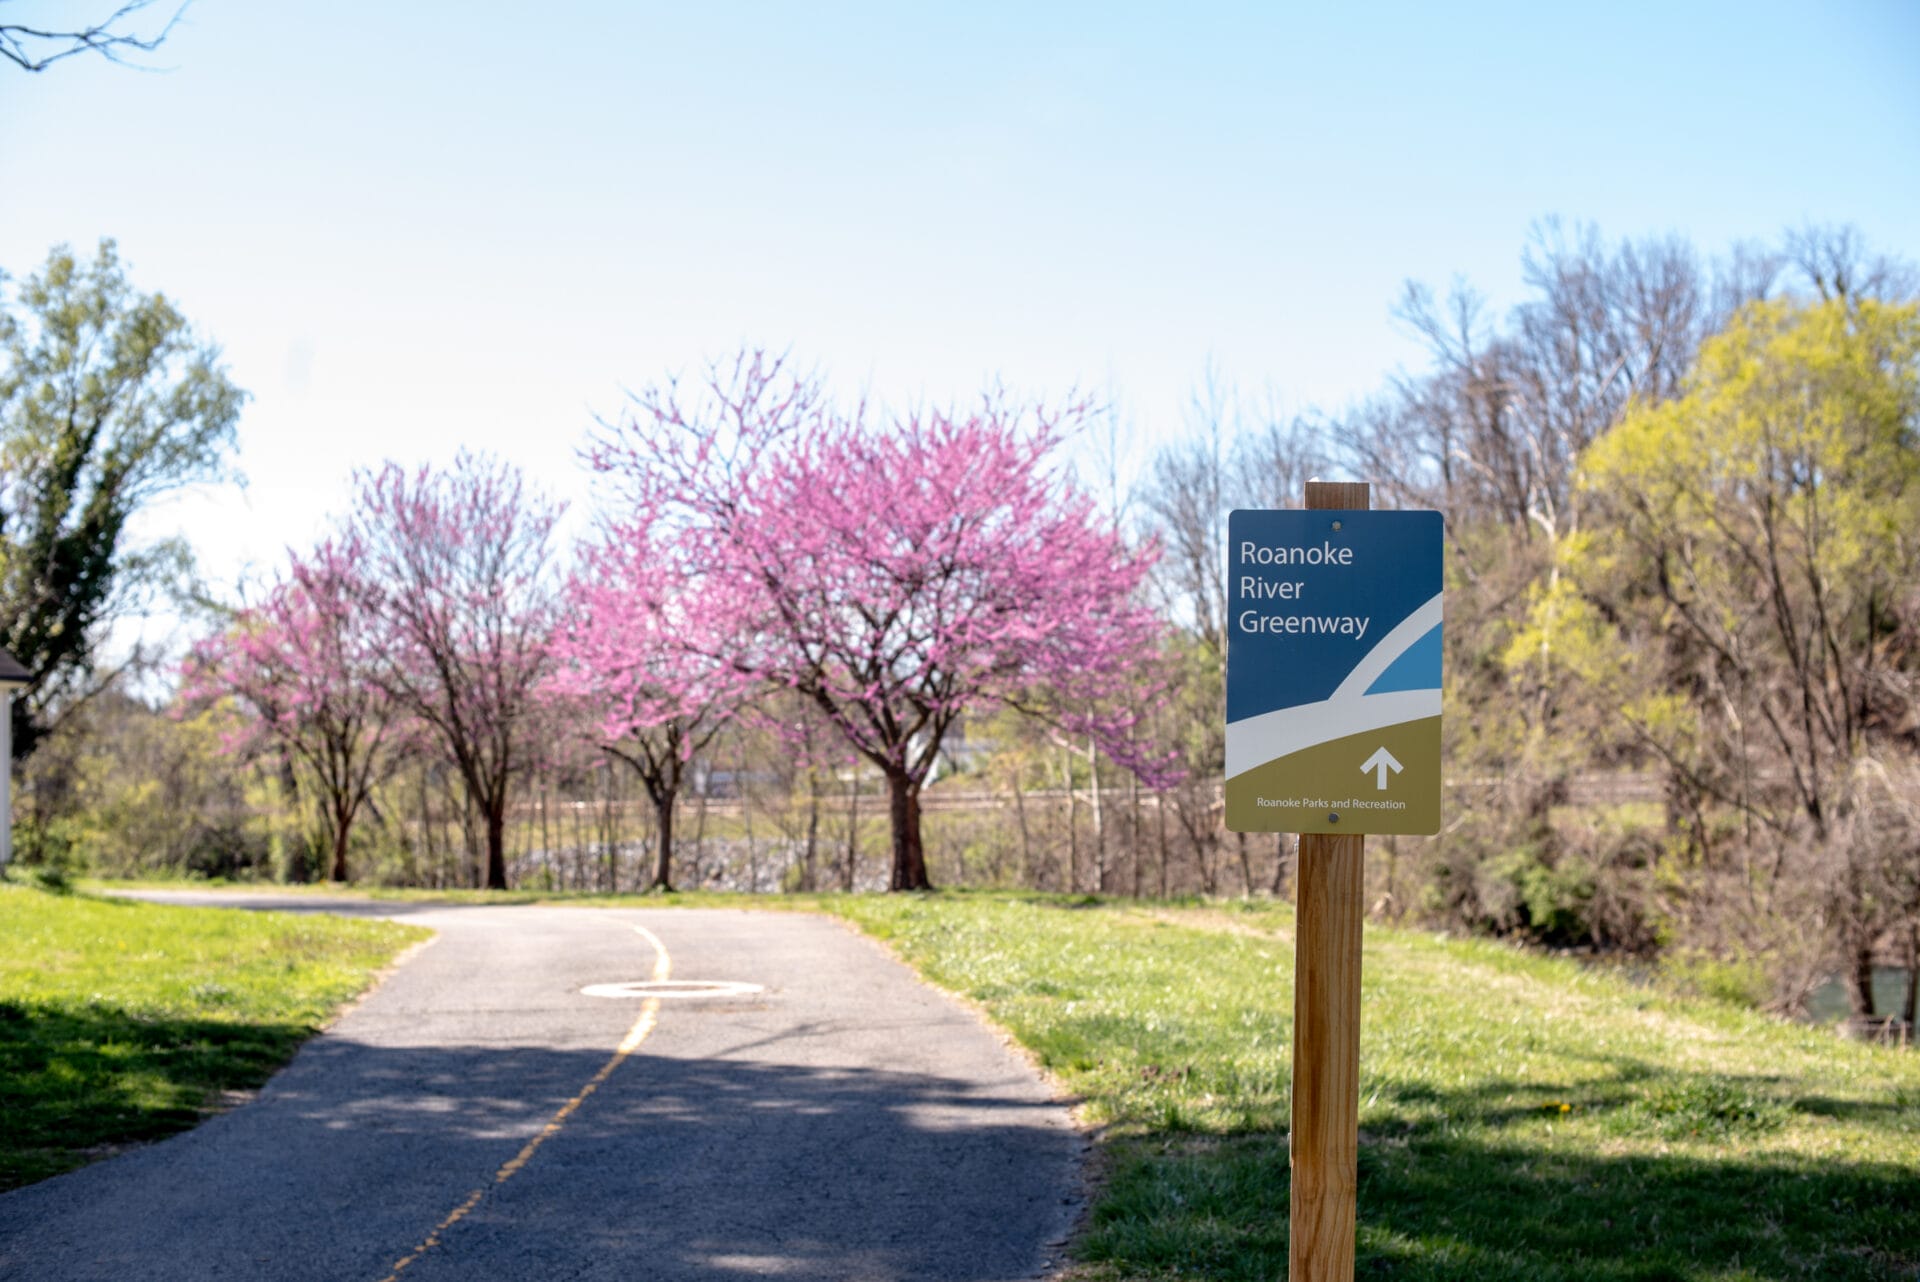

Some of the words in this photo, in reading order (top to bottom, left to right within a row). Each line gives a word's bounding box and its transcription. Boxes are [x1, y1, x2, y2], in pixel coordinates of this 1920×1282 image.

[1241, 540, 1353, 565] Roanoke
[1240, 575, 1304, 599] River
[1239, 610, 1370, 640] Greenway
[1257, 797, 1301, 808] Roanoke
[1302, 797, 1329, 809] Parks
[1330, 798, 1350, 809] and
[1352, 798, 1406, 810] Recreation
